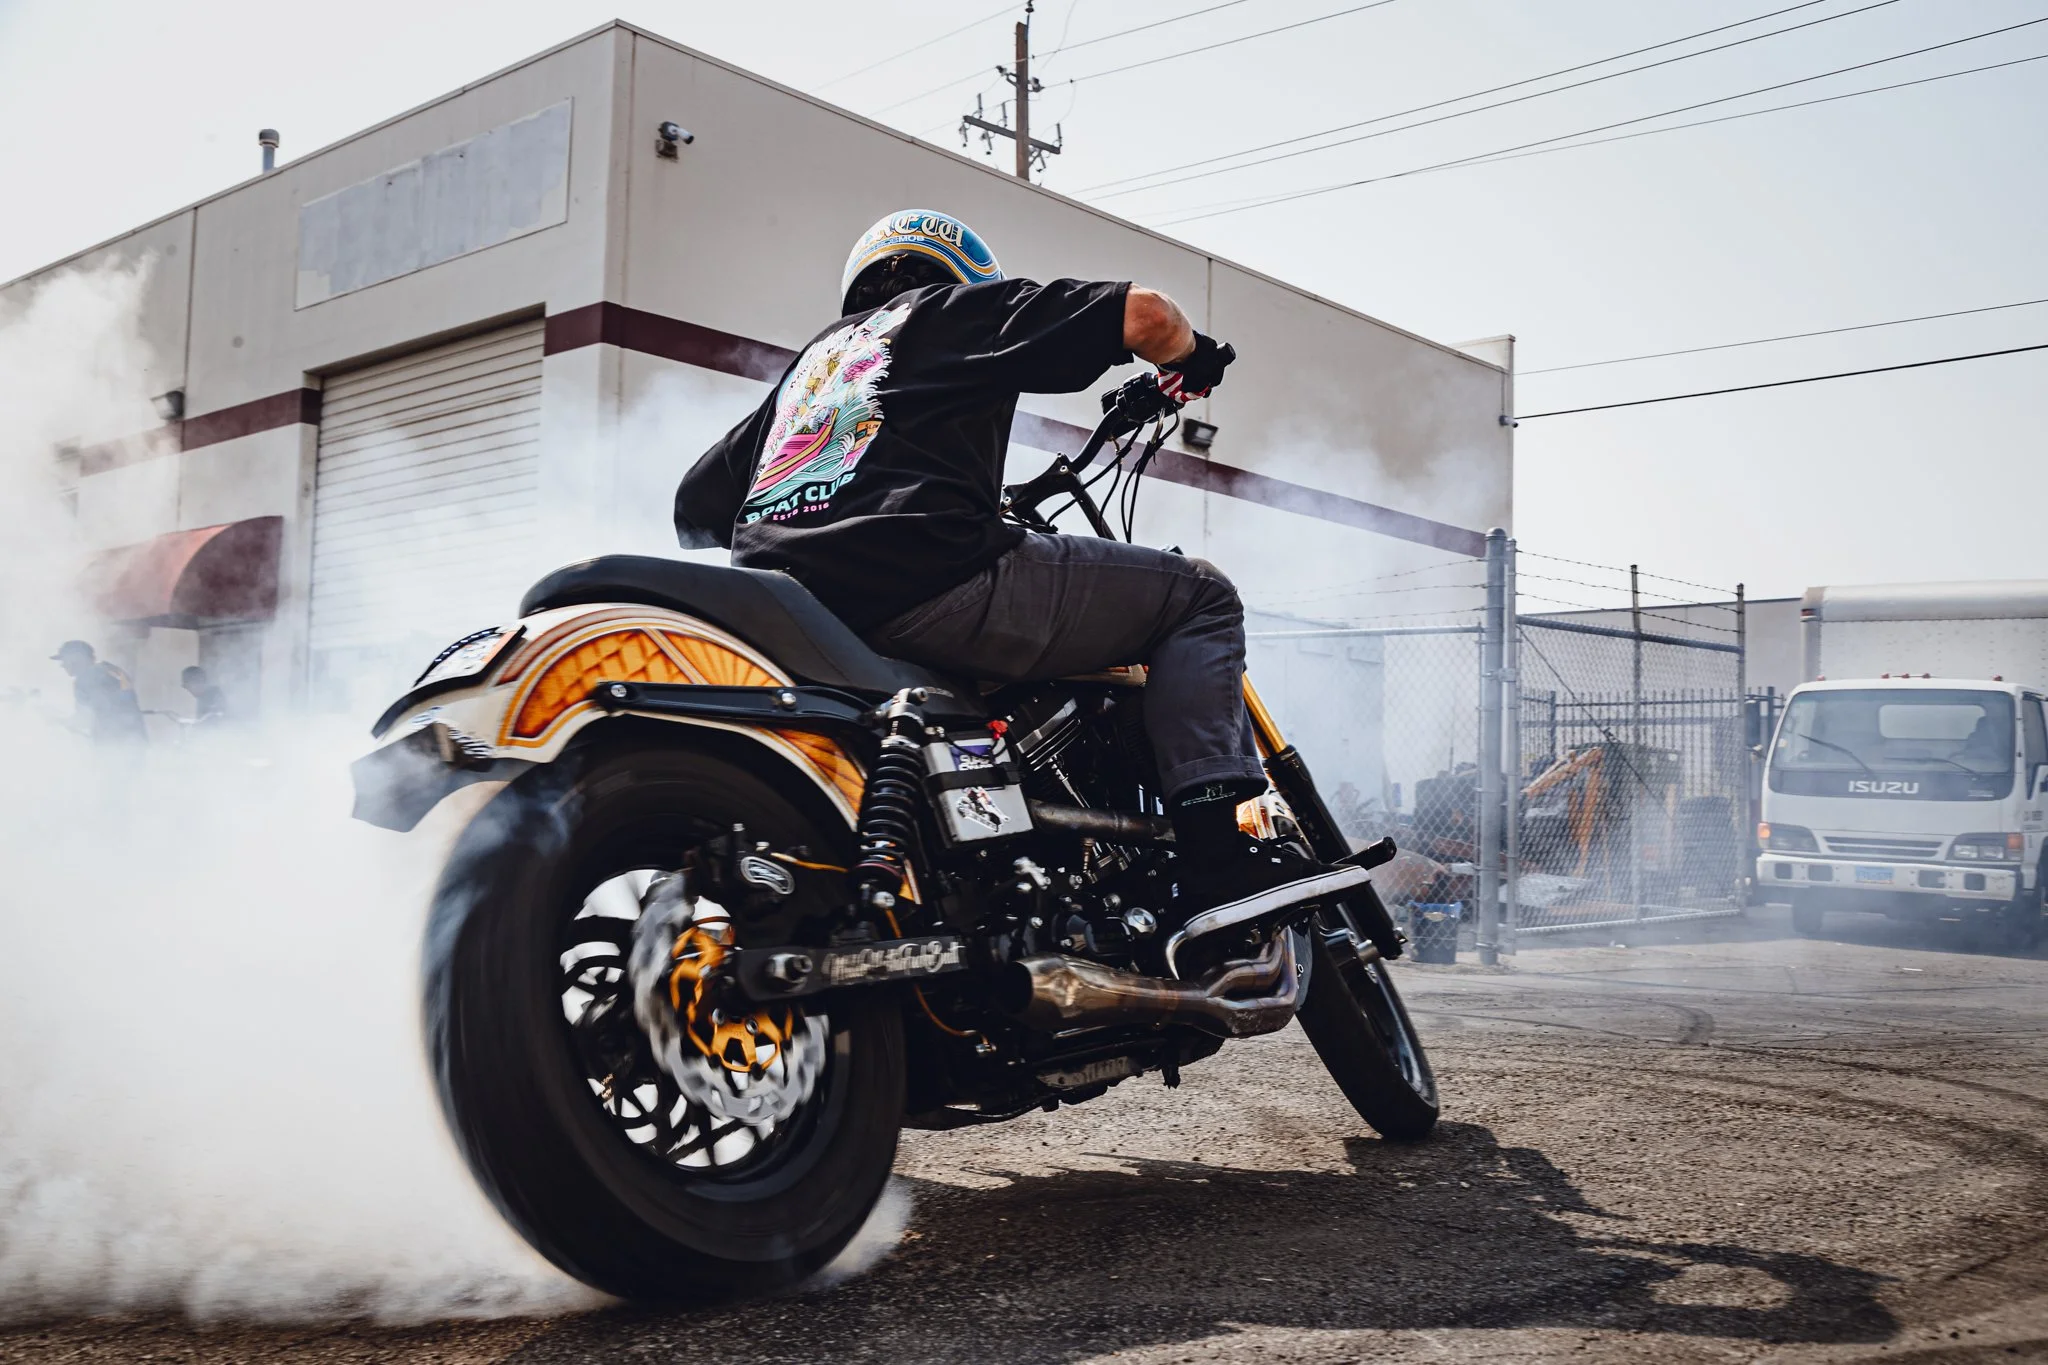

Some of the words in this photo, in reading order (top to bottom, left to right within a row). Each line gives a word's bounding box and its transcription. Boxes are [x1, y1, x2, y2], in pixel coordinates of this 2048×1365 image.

[745, 492, 802, 525] BOAT
[805, 472, 857, 502] CLUB
[1848, 780, 1920, 795] ISUZU
